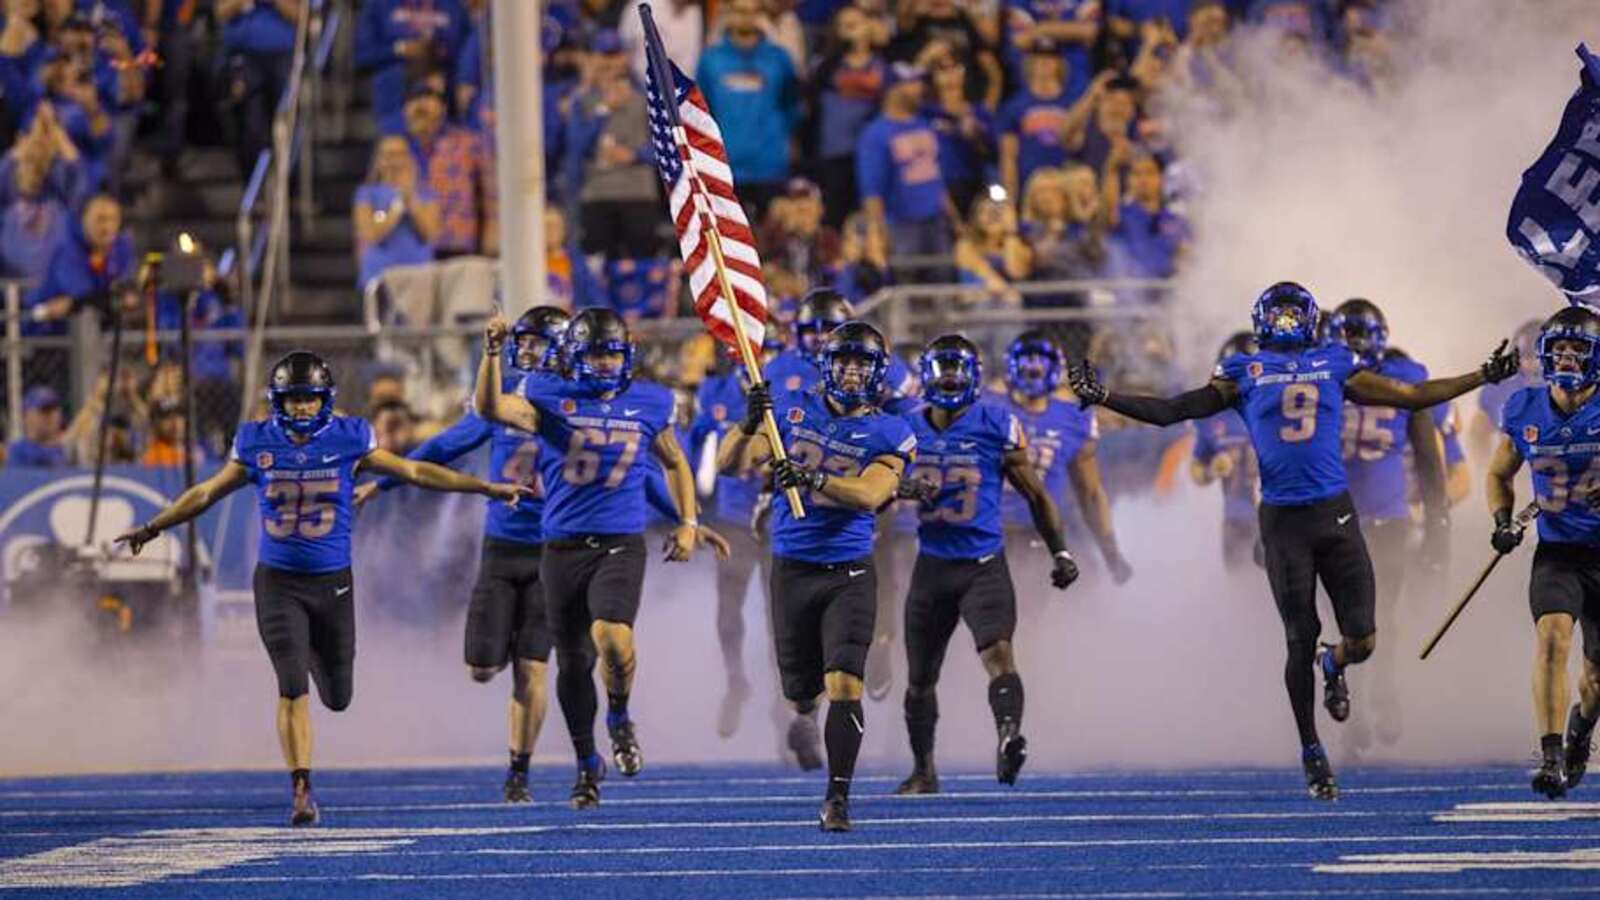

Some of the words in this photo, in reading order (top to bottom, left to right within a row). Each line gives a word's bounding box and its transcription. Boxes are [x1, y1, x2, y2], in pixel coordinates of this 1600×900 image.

[1280, 383, 1320, 442] 9
[563, 427, 643, 487] 67
[264, 480, 340, 539] 35
